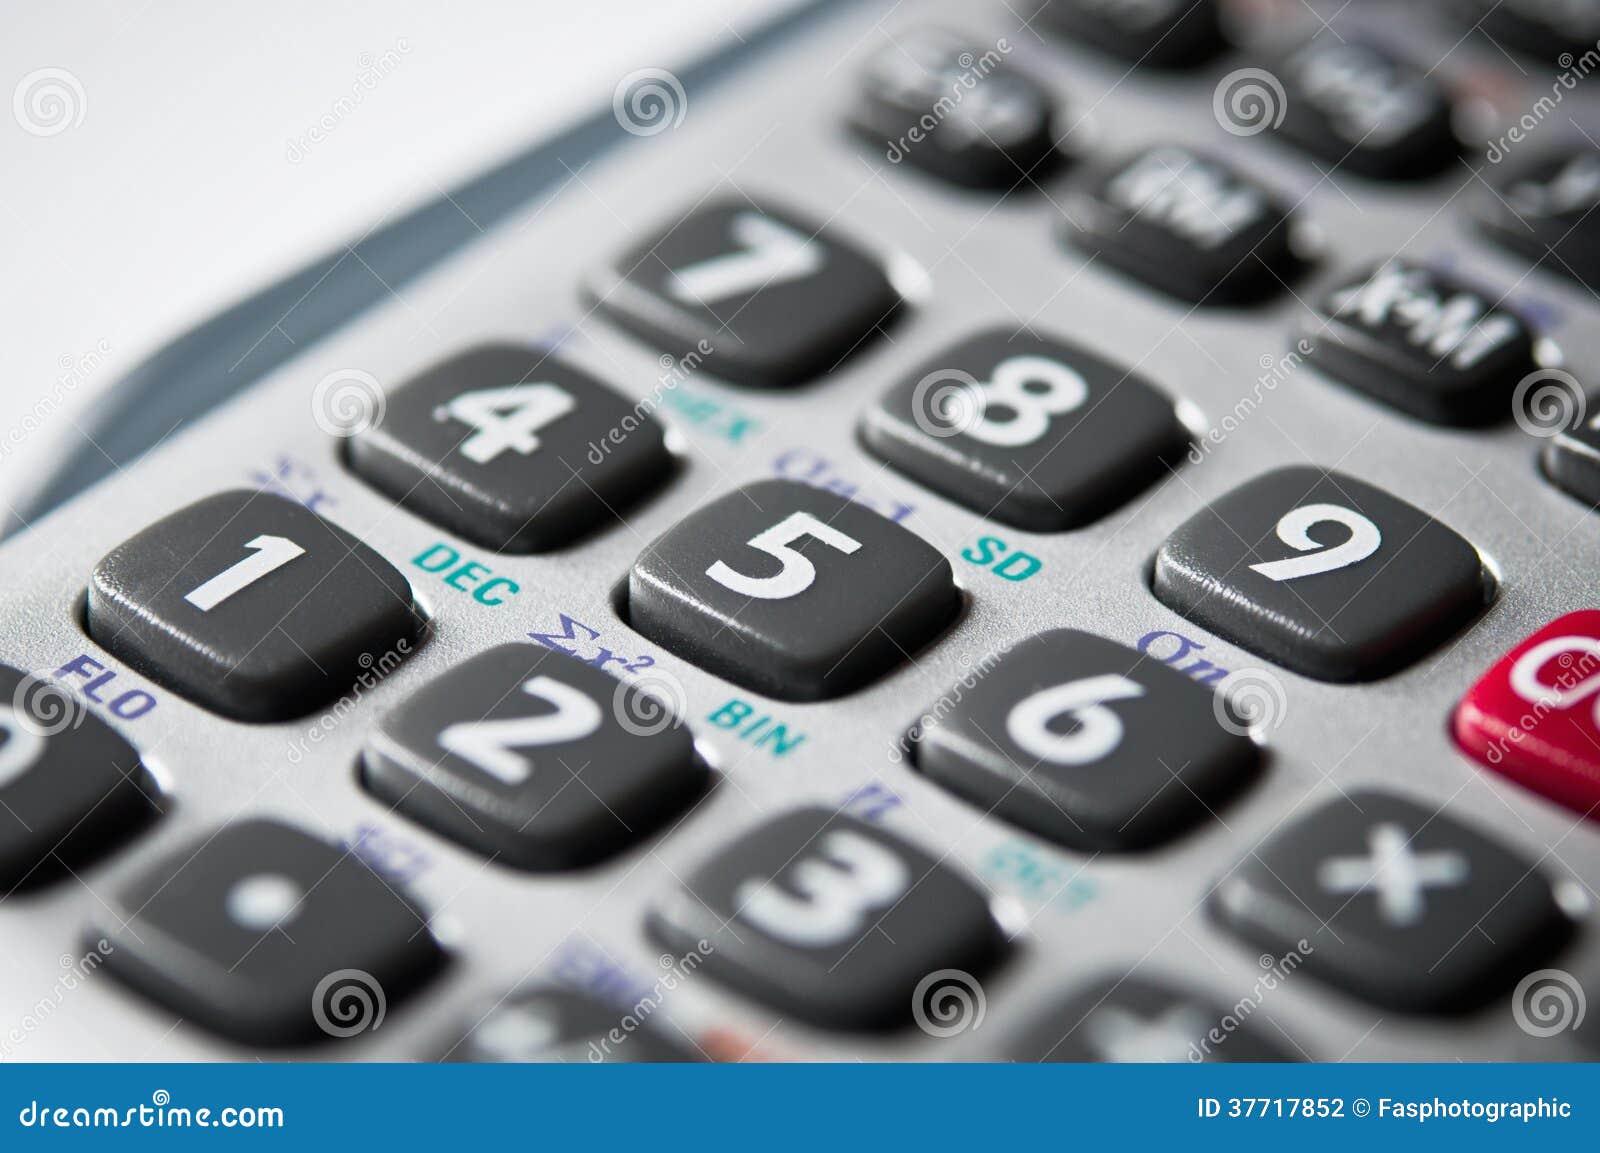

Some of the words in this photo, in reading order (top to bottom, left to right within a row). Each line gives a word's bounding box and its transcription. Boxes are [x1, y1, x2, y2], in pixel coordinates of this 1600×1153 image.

[668, 215, 820, 307] 7
[432, 384, 574, 463] 4
[950, 357, 1087, 446] 8
[184, 535, 306, 611] 1
[410, 543, 520, 606] DEC
[705, 511, 863, 599] 5
[961, 537, 1042, 581] SD
[1247, 503, 1382, 582] 9
[52, 654, 157, 720] FLO
[1007, 674, 1142, 764] 6
[437, 675, 602, 783] 2
[708, 699, 807, 756] BIN
[736, 831, 907, 944] 3
